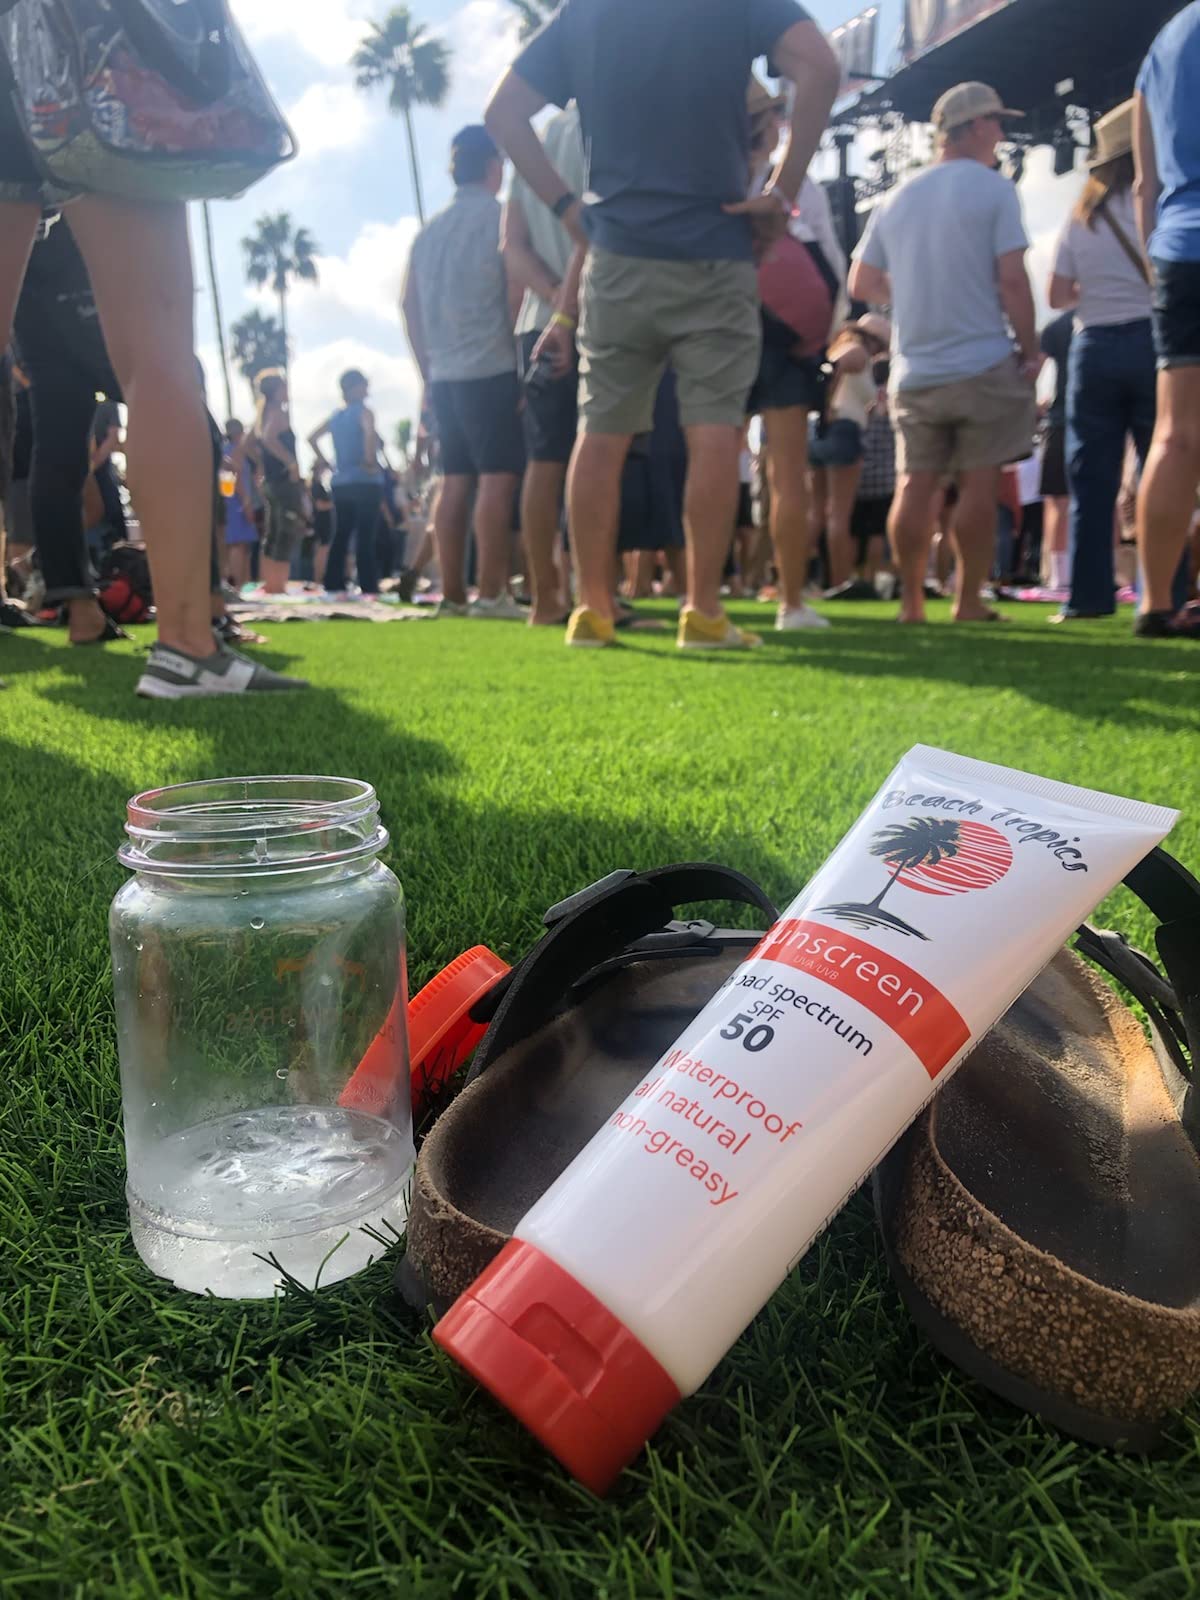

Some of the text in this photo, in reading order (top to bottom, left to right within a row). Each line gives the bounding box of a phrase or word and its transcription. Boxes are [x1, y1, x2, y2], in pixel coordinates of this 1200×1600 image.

[882, 790, 1088, 873] Beach Tropics
[719, 1012, 775, 1052] 50
[747, 1000, 785, 1022] SPF
[768, 983, 874, 1057] spectrum
[634, 1076, 752, 1155] all natural
[661, 1049, 803, 1143] Waterproof
[609, 1110, 739, 1206] non-greasy
